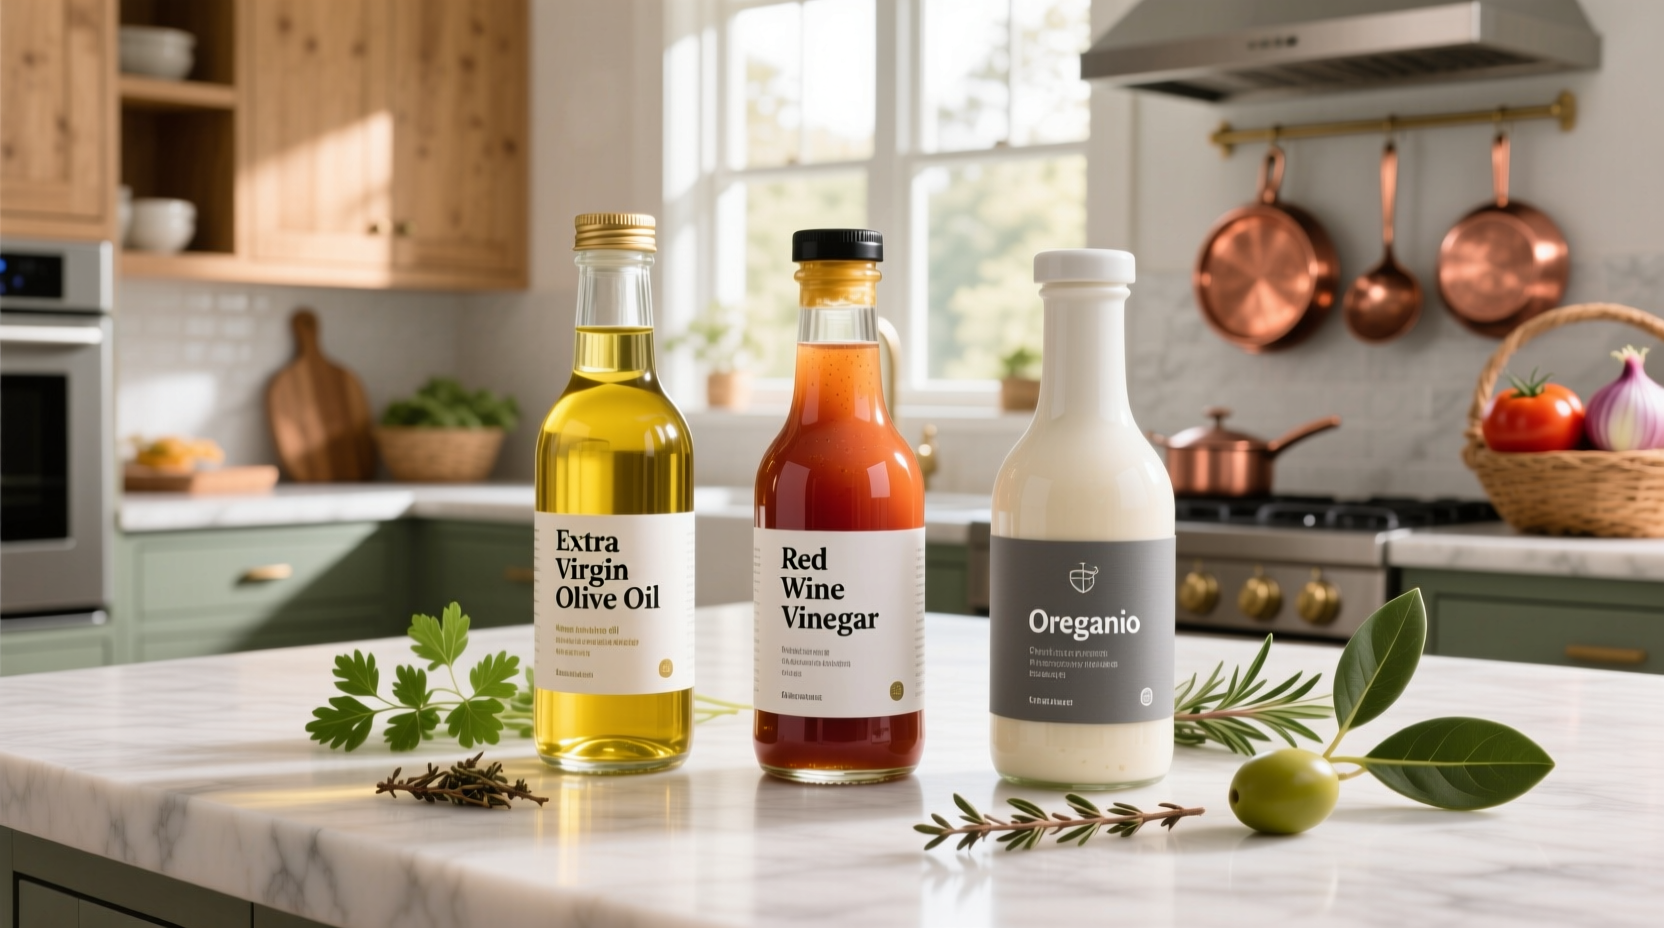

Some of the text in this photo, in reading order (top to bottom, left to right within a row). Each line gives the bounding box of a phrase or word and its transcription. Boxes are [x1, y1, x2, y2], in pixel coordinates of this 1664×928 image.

[555, 529, 620, 553] Extra
[781, 547, 828, 571] Red
[555, 557, 629, 588] Virgin
[555, 584, 661, 610] Olive Oil
[780, 576, 845, 600] Wine
[781, 605, 880, 637] Vinegar
[1028, 608, 1141, 642] Oreganio
